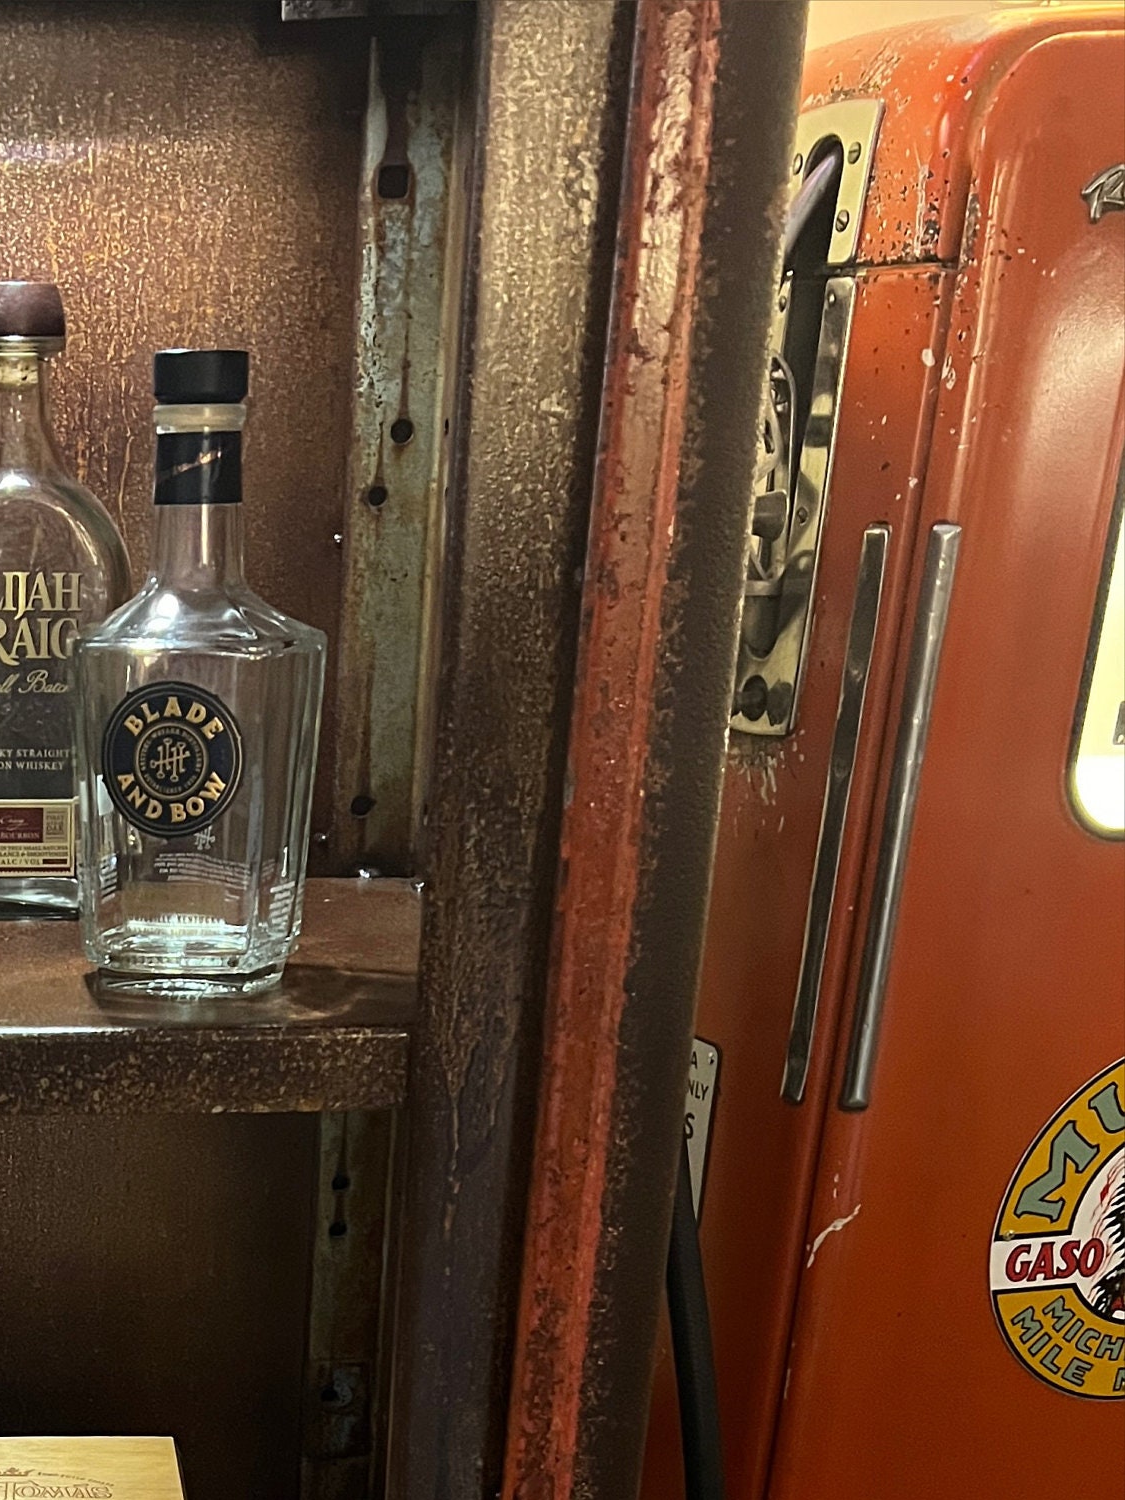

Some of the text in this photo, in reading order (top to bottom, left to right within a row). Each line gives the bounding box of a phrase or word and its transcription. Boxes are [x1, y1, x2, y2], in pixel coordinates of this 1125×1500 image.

[123, 696, 224, 740] BLADE
[16, 748, 70, 758] STRAIGHT
[16, 761, 64, 770] WHISKEY
[117, 771, 226, 823] AND BOW
[1005, 1238, 1105, 1283] GASO
[1011, 1306, 1093, 1387] MILE
